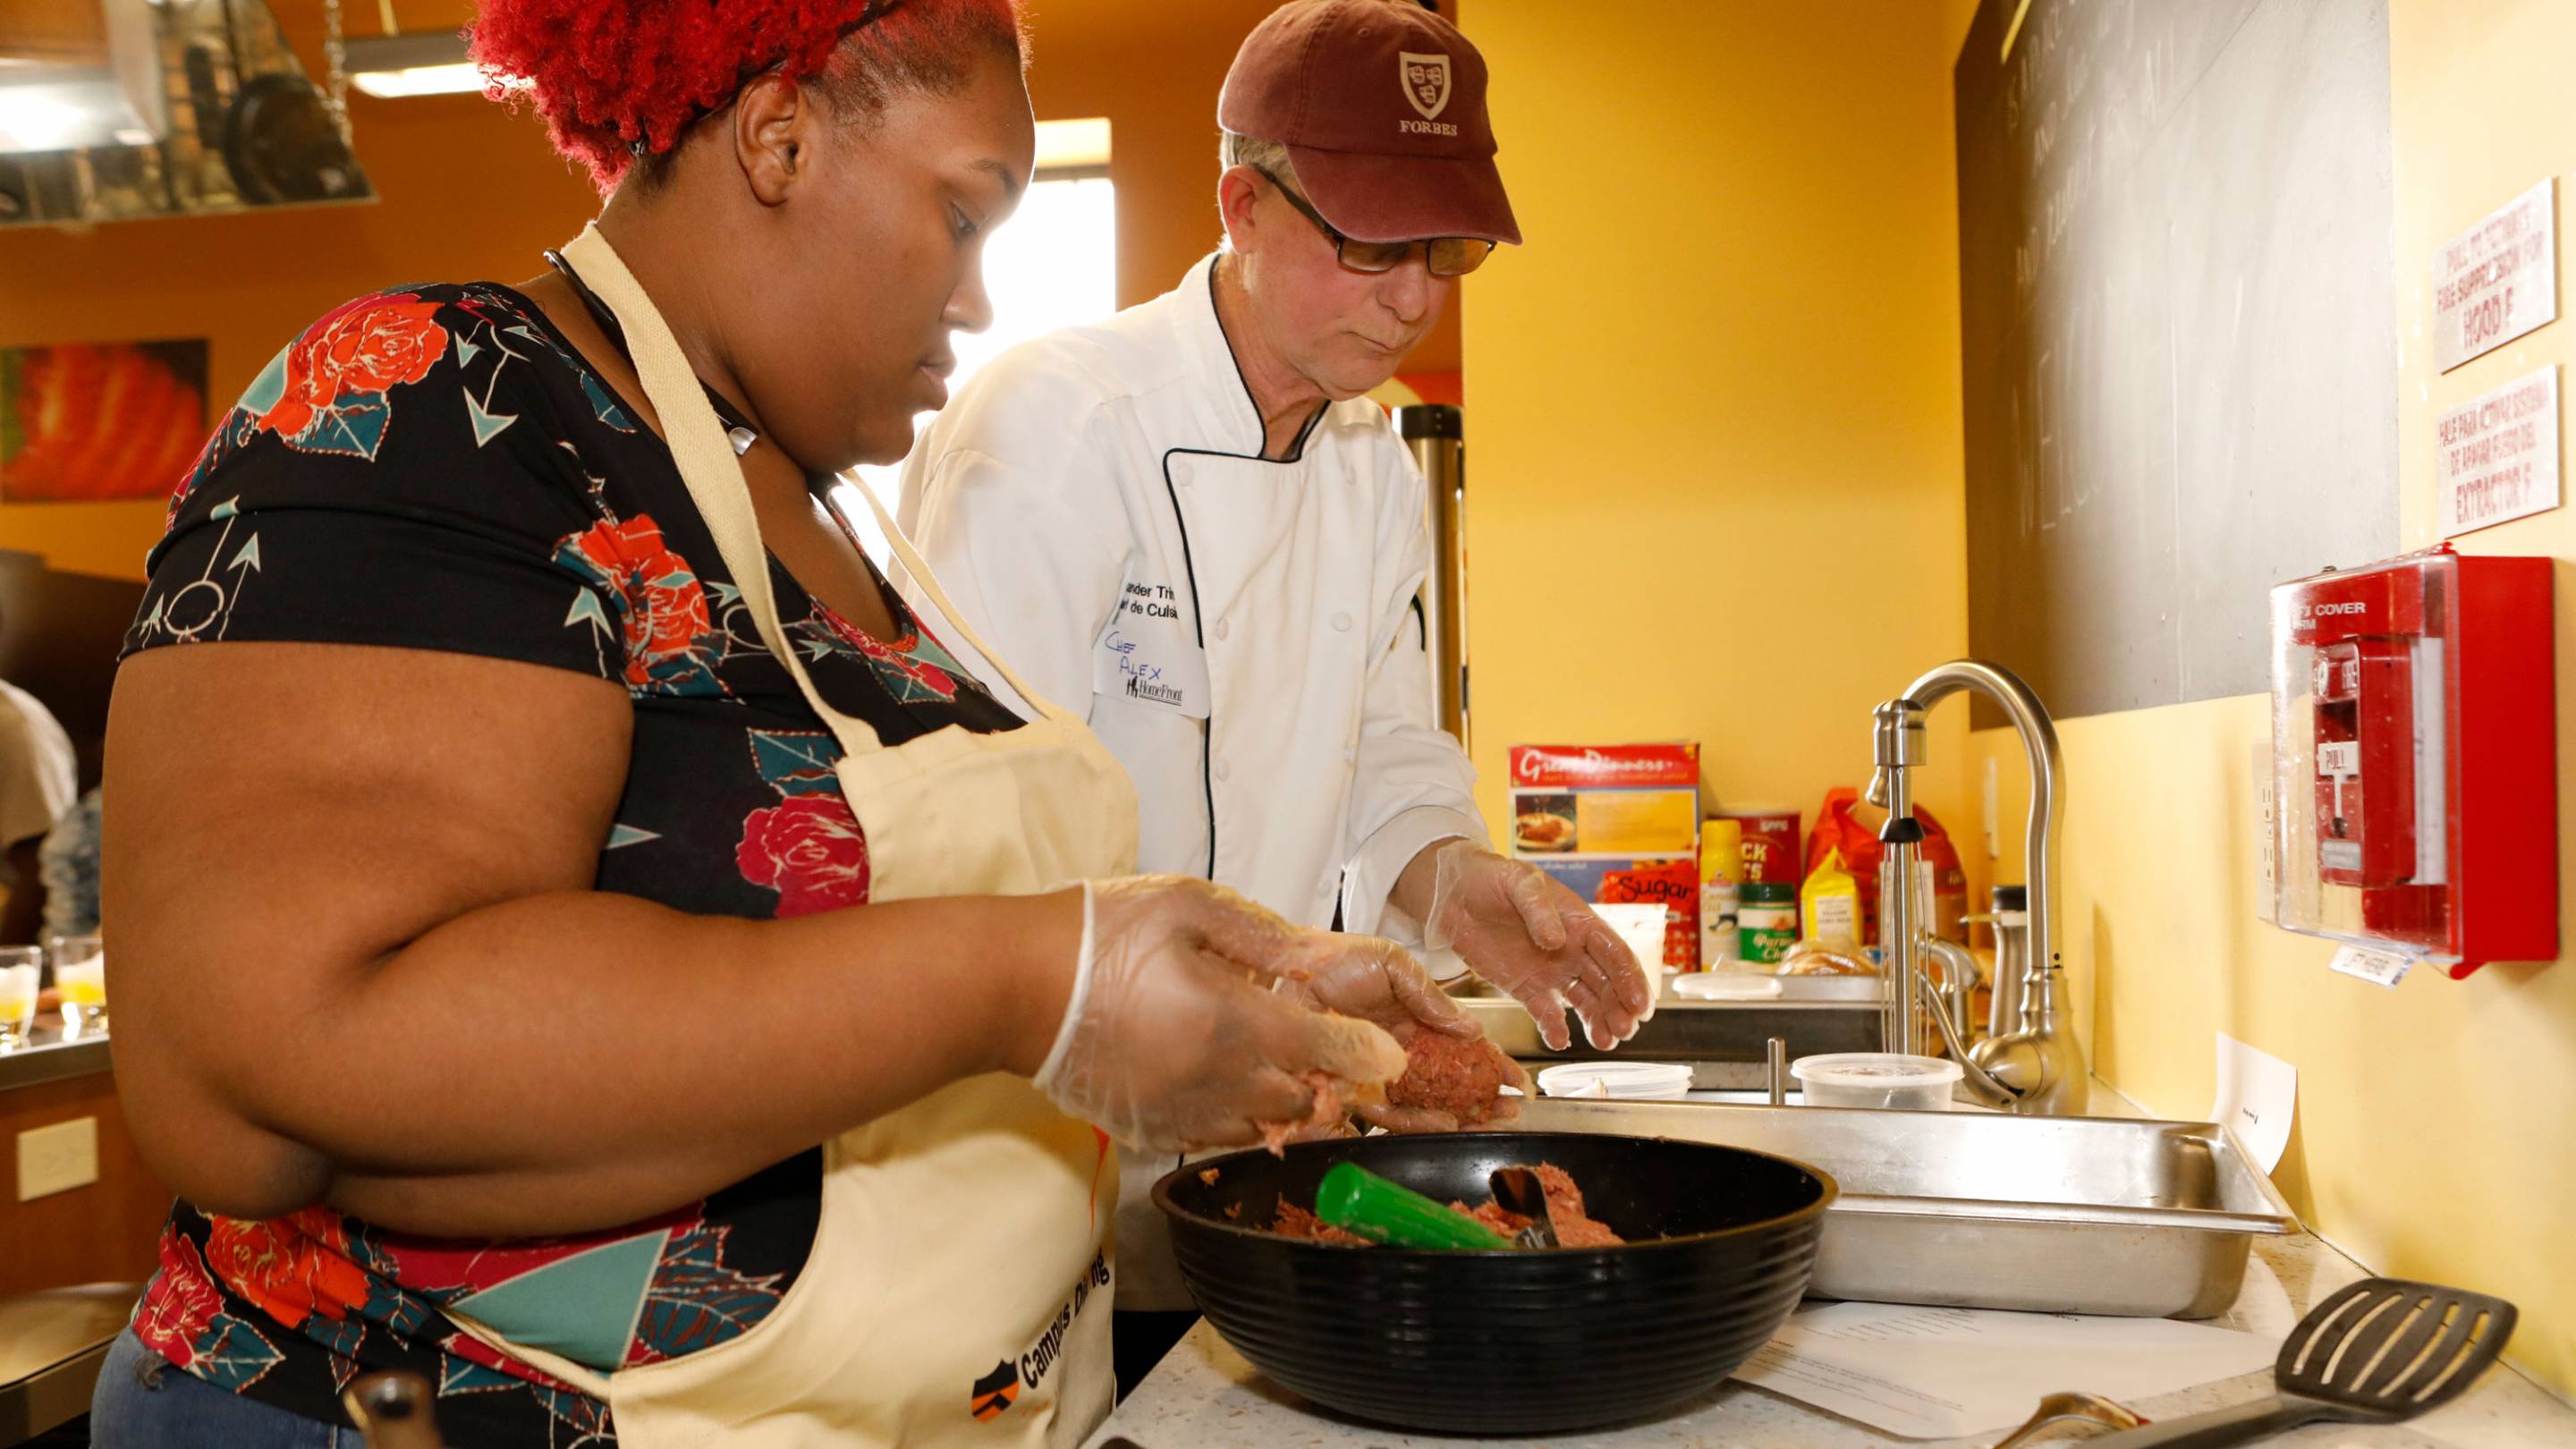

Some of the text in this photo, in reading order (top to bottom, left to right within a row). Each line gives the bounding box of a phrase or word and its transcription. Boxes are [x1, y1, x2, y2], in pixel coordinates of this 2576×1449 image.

[1399, 120, 1458, 136] FORBES
[2463, 293, 2502, 351] HOOD
[1131, 600, 1144, 614] de
[2315, 602, 2367, 616] COVER
[1105, 631, 1137, 654] CHEF
[1119, 656, 1162, 680] ALEX
[1619, 876, 1694, 903] Sugar
[1021, 1303, 1072, 1389] Campus
